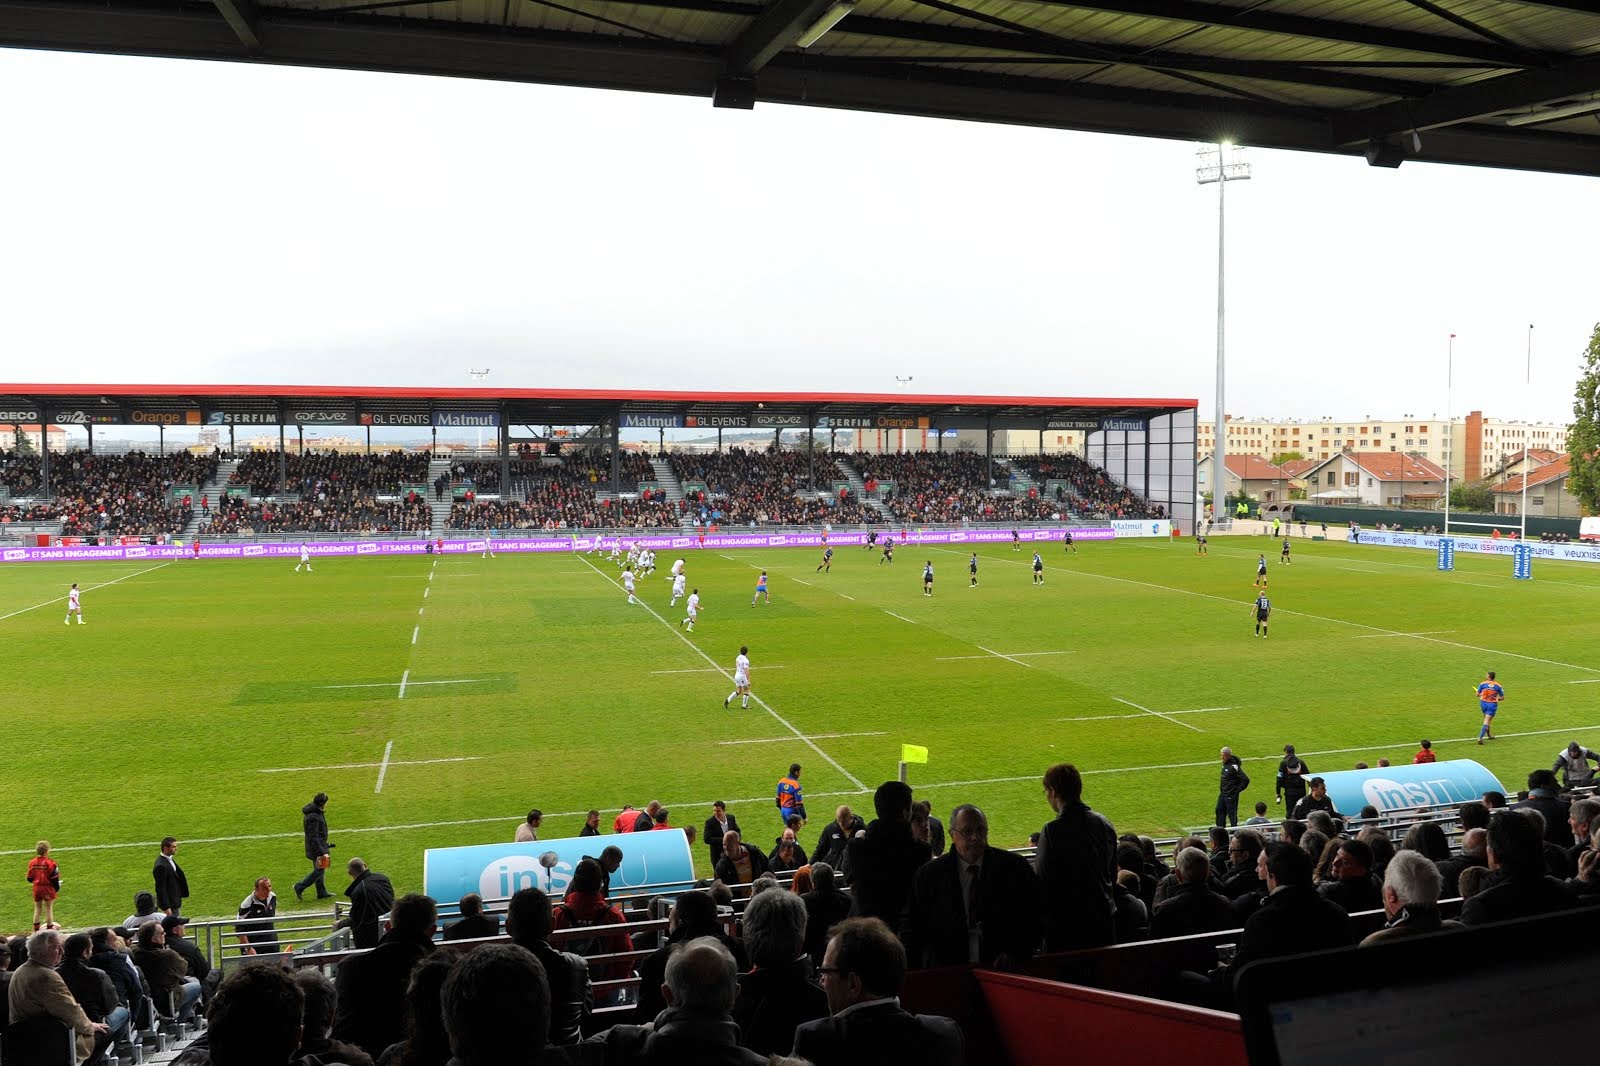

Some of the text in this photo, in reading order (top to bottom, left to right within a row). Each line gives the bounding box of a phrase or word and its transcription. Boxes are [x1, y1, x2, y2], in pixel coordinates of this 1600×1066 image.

[0, 411, 37, 420] GECO
[132, 411, 180, 424] Orange
[223, 413, 276, 423] SERFIM
[295, 412, 316, 420] GDF
[373, 414, 429, 424] GL EVENTS
[437, 413, 494, 426] Matmut
[757, 416, 775, 424] GDF
[625, 415, 678, 427] Matmut
[697, 416, 747, 426] GL EVENTS
[829, 418, 871, 427] SERFIM
[877, 417, 914, 428] Orange
[1102, 419, 1143, 430] Matmut
[1113, 522, 1143, 530] Matmut
[1075, 530, 1115, 538] ENGAGEMENT
[520, 541, 570, 549] ENGAGEMENT
[65, 549, 122, 558] ENGAGEMENT
